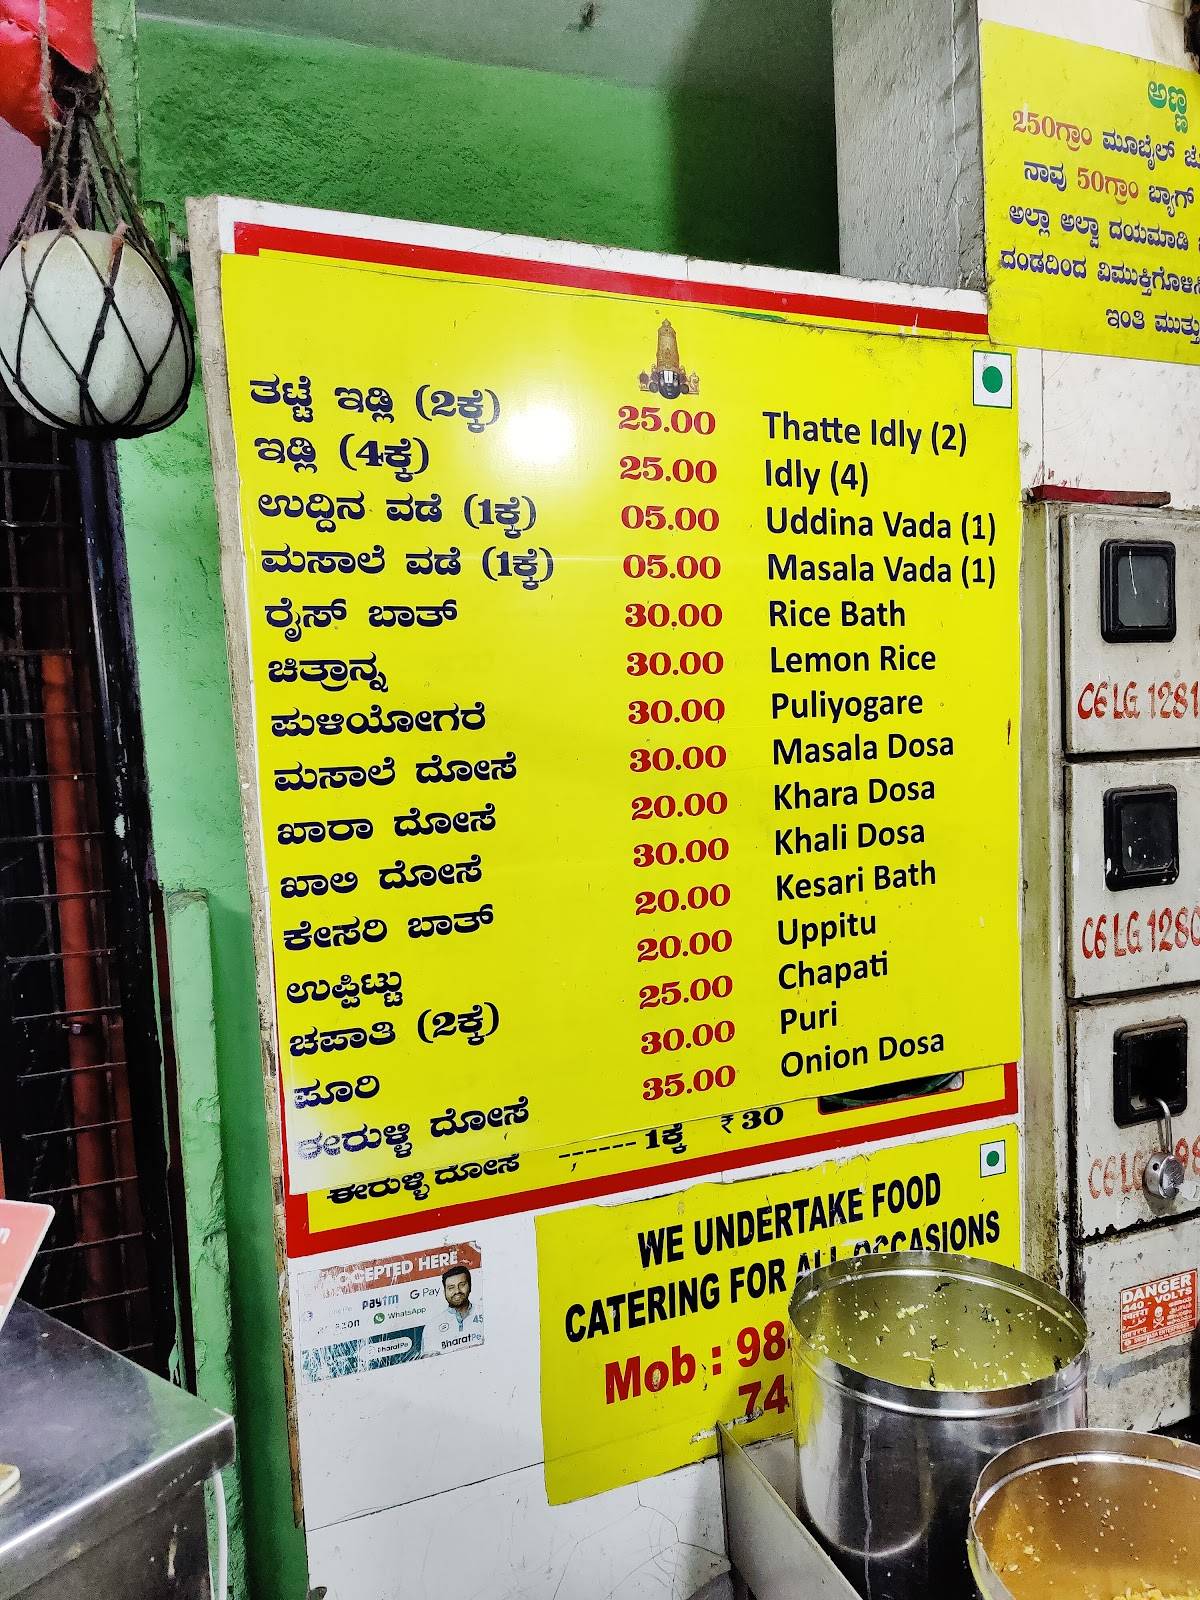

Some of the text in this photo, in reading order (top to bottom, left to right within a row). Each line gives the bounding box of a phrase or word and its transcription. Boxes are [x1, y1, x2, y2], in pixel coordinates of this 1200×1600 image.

[1012, 110, 1093, 152] 250ಗ್ರಾಂ
[1024, 160, 1194, 217] ನಾವು 50ಗ್ರಾಂ ಬ್ಯಾಗ್
[1009, 205, 1050, 238] ಅಲ್ಲಾ
[1109, 217, 1188, 251] ದಯಮಾಡಿ
[1000, 246, 1086, 280] ದಂಡದಿಂದ
[1106, 308, 1145, 329] ಇಂತಿ
[250, 374, 499, 432] ತಟ್ಟೆ ಇಡ್ಲಿ (2ಕ್ಕೆ)
[619, 406, 715, 434] 25.00
[763, 411, 966, 457] Thatte Idly (2)
[255, 434, 429, 482] ಇಡ್ಲಿ (4ಕ್ಕೆ)
[620, 456, 717, 483] 25.00
[766, 459, 868, 497] Idly (4)
[258, 491, 536, 539] ಉದ್ದಿನ ವಡೆ (1ಕ್ಕೆ)
[622, 506, 719, 531] 05.00
[767, 507, 995, 546] Uddina Vada (1)
[261, 544, 553, 590] ಮಸಾಲೆ ವಡೆ (1ಕ್ಕೆ)
[624, 555, 720, 579] 05.00
[768, 554, 995, 589] Masala Vada (1)
[265, 598, 457, 642] ರೈಸ್ ಬಾತ್
[625, 604, 722, 627] 30.00
[770, 600, 905, 626] Rice Bath
[268, 652, 388, 692] ಚಿತ್ರಾನ್ನ
[627, 652, 723, 676] 30.00
[771, 645, 935, 672] Lemon Rice
[271, 702, 485, 737] ಪುಳಿಯೋಗರೆ
[629, 699, 725, 724] 30.00
[772, 690, 922, 723] Puliyogare
[630, 745, 726, 772] 30.00
[774, 734, 953, 764] Masala Dosa
[274, 752, 516, 791] ಮಸಾಲೆ ದೋಸೆ
[632, 792, 727, 820] 20.00
[775, 779, 934, 810] Khara Dosa
[278, 803, 496, 845] ಖಾರಾ ದೋಸೆ
[776, 823, 924, 855] Khali Dosa
[634, 838, 729, 867] 30.00
[281, 854, 482, 898] ಖಾಲಿ ದೋಸೆ
[777, 860, 935, 901] Kesari Bath
[635, 884, 730, 915] 20.00
[284, 904, 493, 950] ಕೇಸರಿ ಬಾತ್
[778, 912, 875, 949] Uppitu
[637, 930, 732, 962] 20.00
[779, 950, 887, 989] Chapati
[287, 972, 403, 1009] ಉಪ್ಪಿಟ್ಟು
[639, 976, 732, 1009] 25.00
[290, 1002, 499, 1056] ಚಪಾತಿ (2ಕ್ಕೆ)
[781, 1001, 836, 1034] Puri
[641, 1021, 735, 1054] 30.00
[781, 1034, 943, 1077] Onion Dosa
[294, 1075, 380, 1109] ಪೂರಿ
[643, 1066, 735, 1100] 35.00
[297, 1096, 529, 1160] ಈರುಳ್ಳಿ ದೋಸೆ
[638, 1173, 940, 1268] WE UNDERTAKE FOOD
[418, 1250, 458, 1272] HERE
[566, 1273, 719, 1342] CATERING
[730, 1259, 786, 1303] FOR
[1122, 1274, 1192, 1305] DANGER
[1154, 1287, 1193, 1303] VOLTS
[388, 1306, 427, 1320] WhatsApp
[441, 1333, 482, 1349] BharatPe
[606, 1345, 696, 1404] Mob
[737, 1320, 791, 1370] 98
